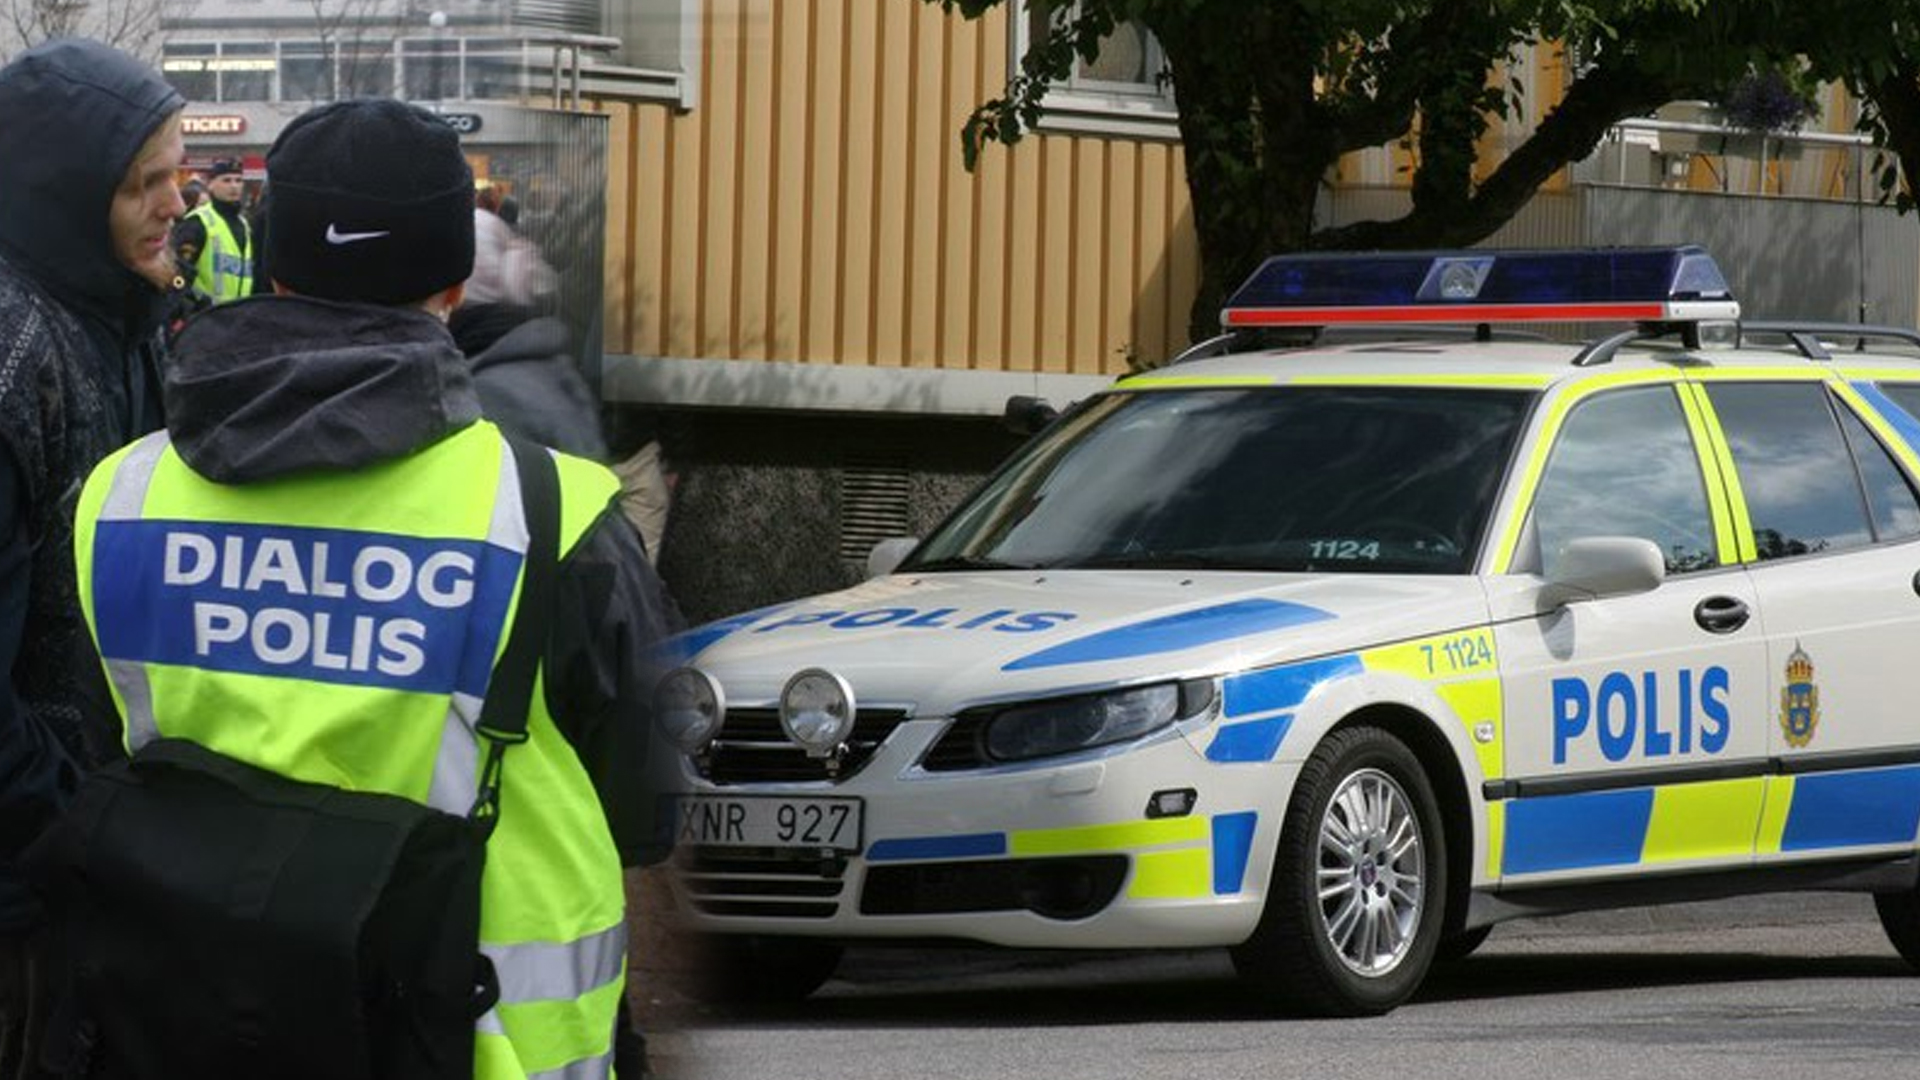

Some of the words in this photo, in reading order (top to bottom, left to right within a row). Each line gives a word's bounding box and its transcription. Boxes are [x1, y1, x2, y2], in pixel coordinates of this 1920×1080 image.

[181, 118, 241, 132] TICKET
[164, 532, 475, 608] DIALOG
[1310, 541, 1379, 560] 1124
[194, 602, 427, 676] POLIS
[753, 608, 1077, 632] POLIS
[1420, 645, 1433, 673] 7
[1443, 635, 1491, 669] 1124
[1552, 665, 1730, 764] POLIS
[681, 802, 744, 842] XNR
[777, 804, 849, 843] 927
